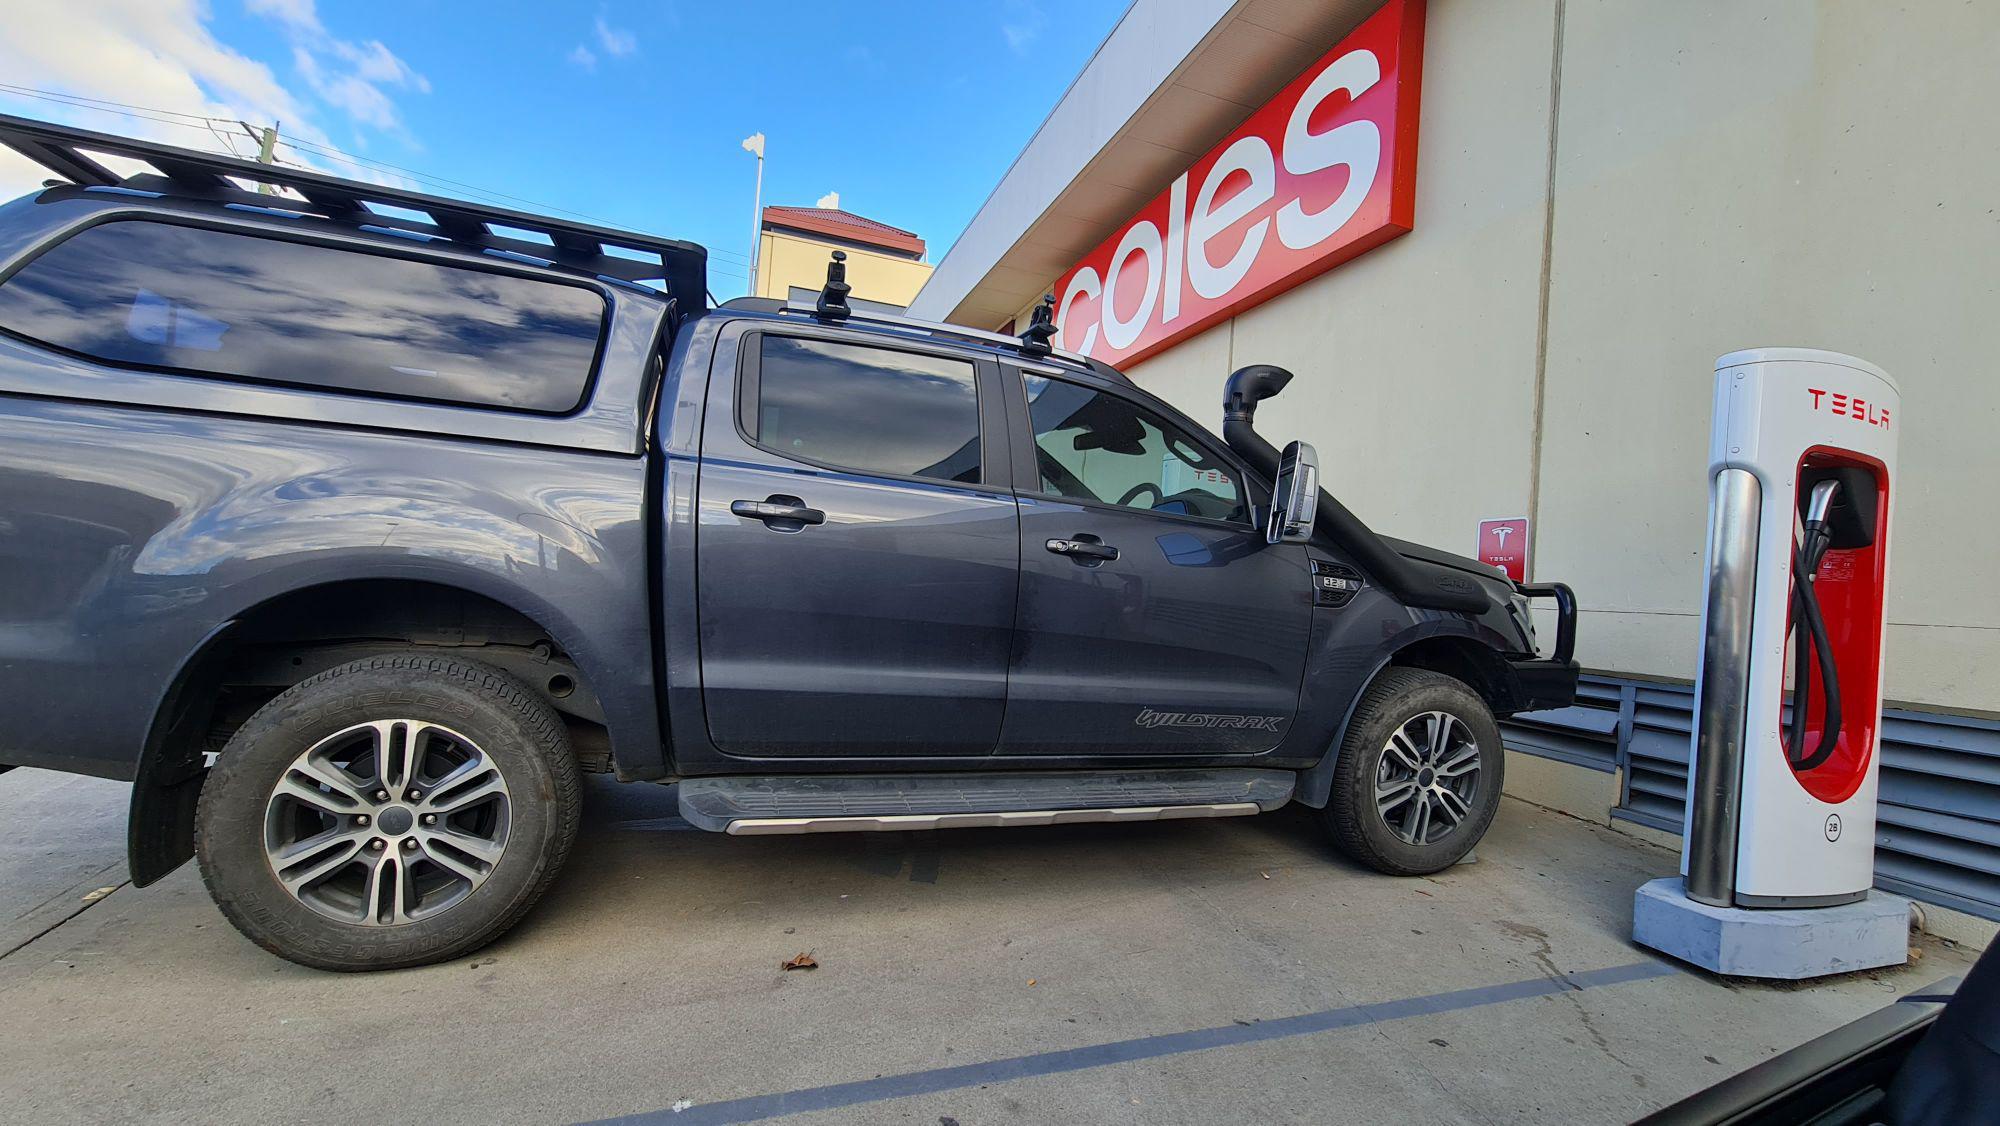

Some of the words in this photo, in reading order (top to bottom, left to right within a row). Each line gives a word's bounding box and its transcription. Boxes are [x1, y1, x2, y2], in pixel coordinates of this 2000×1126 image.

[1057, 49, 1381, 356] coles
[1808, 388, 1890, 431] TESLA
[1194, 470, 1229, 484] TES
[1135, 708, 1285, 732] WILDTRAK
